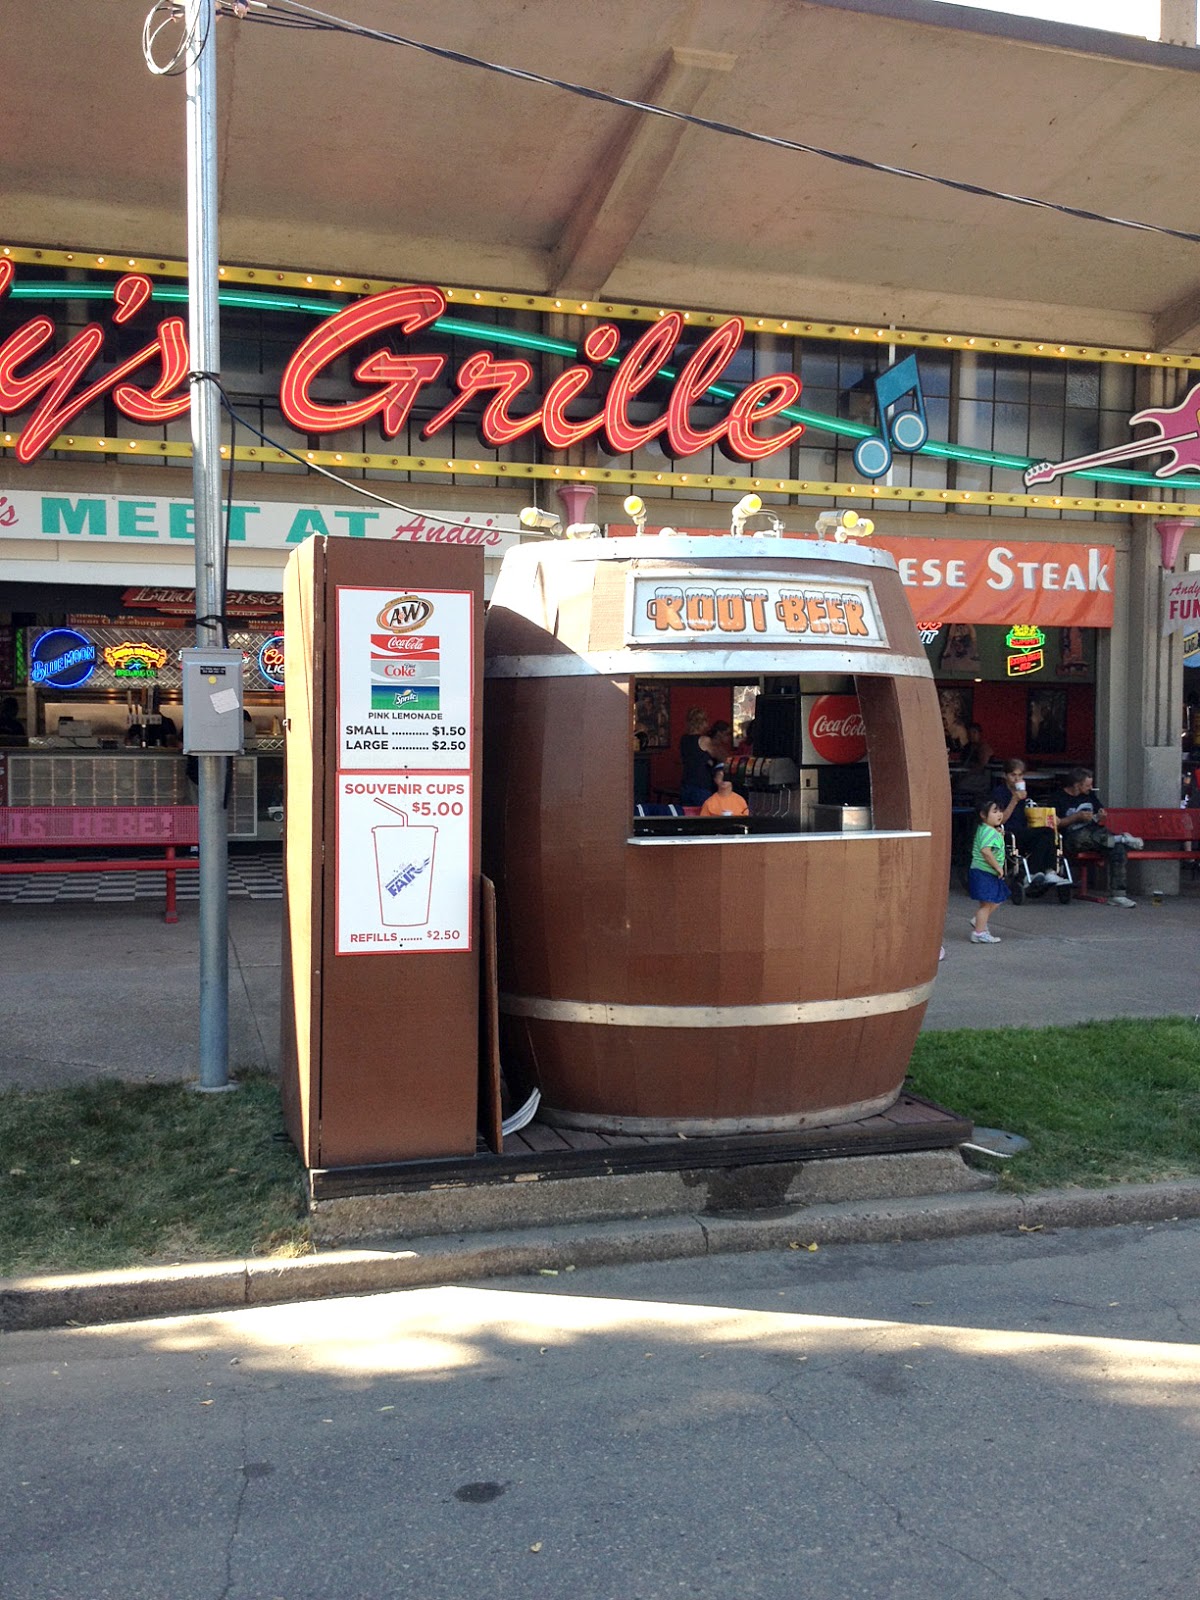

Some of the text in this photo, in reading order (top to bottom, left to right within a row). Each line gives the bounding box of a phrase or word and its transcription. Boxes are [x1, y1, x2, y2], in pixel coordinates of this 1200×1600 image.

[0, 258, 805, 464] y's Grille
[41, 497, 261, 541] MEET
[285, 508, 380, 543] AT
[391, 514, 503, 547] Andy's
[647, 586, 870, 636] ROOT BEER
[384, 664, 416, 677] Coke
[396, 692, 418, 705] Sprite
[368, 712, 443, 720] PINK LEMONADE
[346, 725, 466, 737] SMALL $1.50
[346, 740, 466, 751] LARGE $2.50
[344, 783, 465, 795] SOUVENIR CUPS
[412, 801, 464, 817] $5.00
[350, 929, 460, 943] REFILLS $2.50
